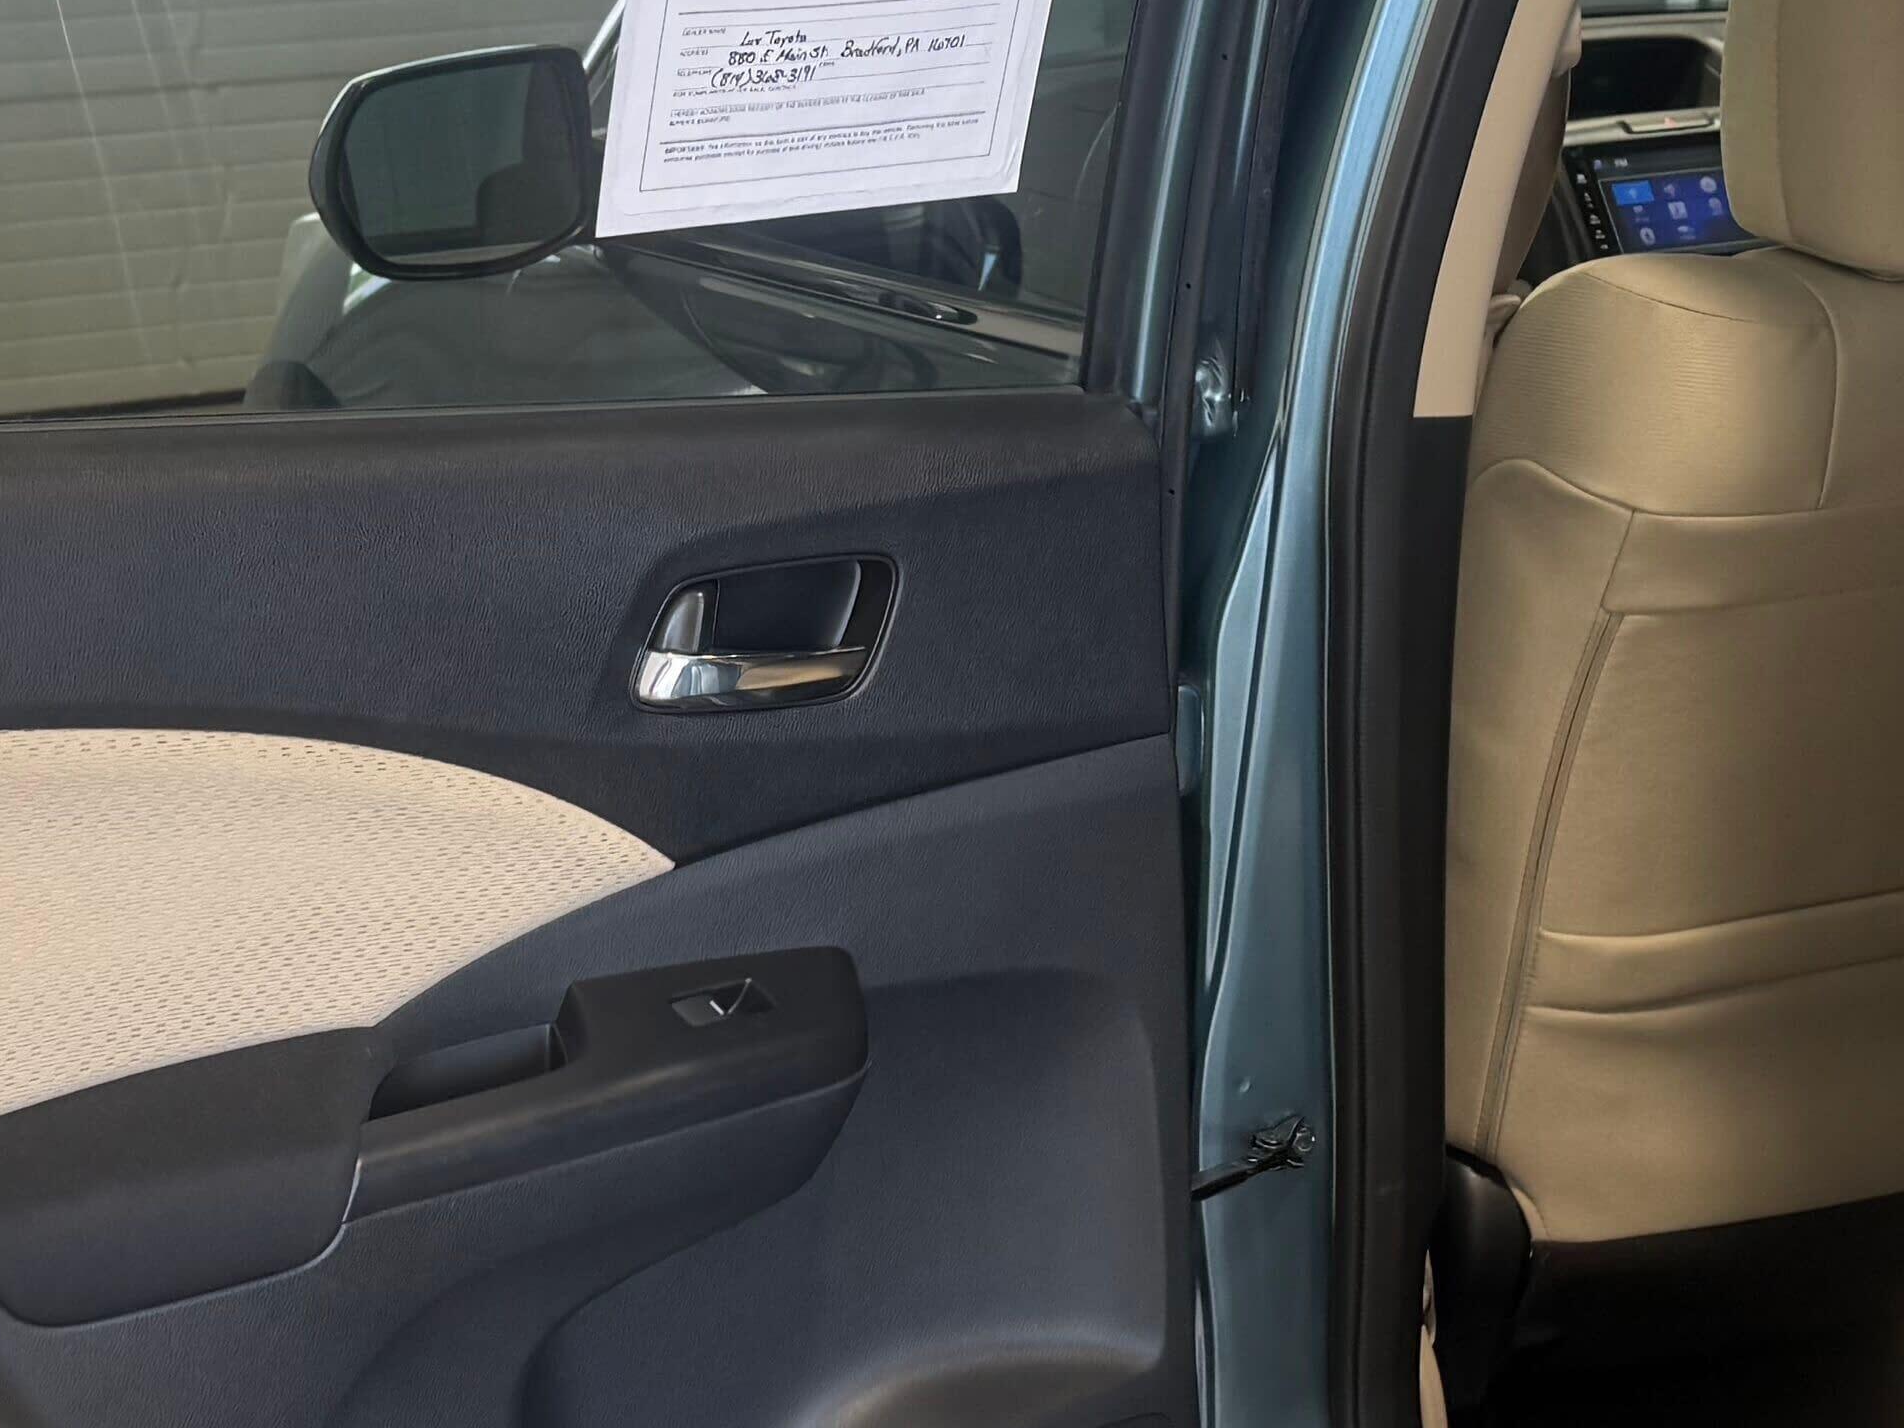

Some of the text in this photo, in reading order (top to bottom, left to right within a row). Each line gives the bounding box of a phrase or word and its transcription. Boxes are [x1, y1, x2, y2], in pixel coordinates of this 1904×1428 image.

[728, 50, 756, 66] 880
[775, 47, 807, 62] Main
[904, 36, 920, 54] PA
[927, 33, 966, 53] 16701
[765, 29, 807, 48] Toyota
